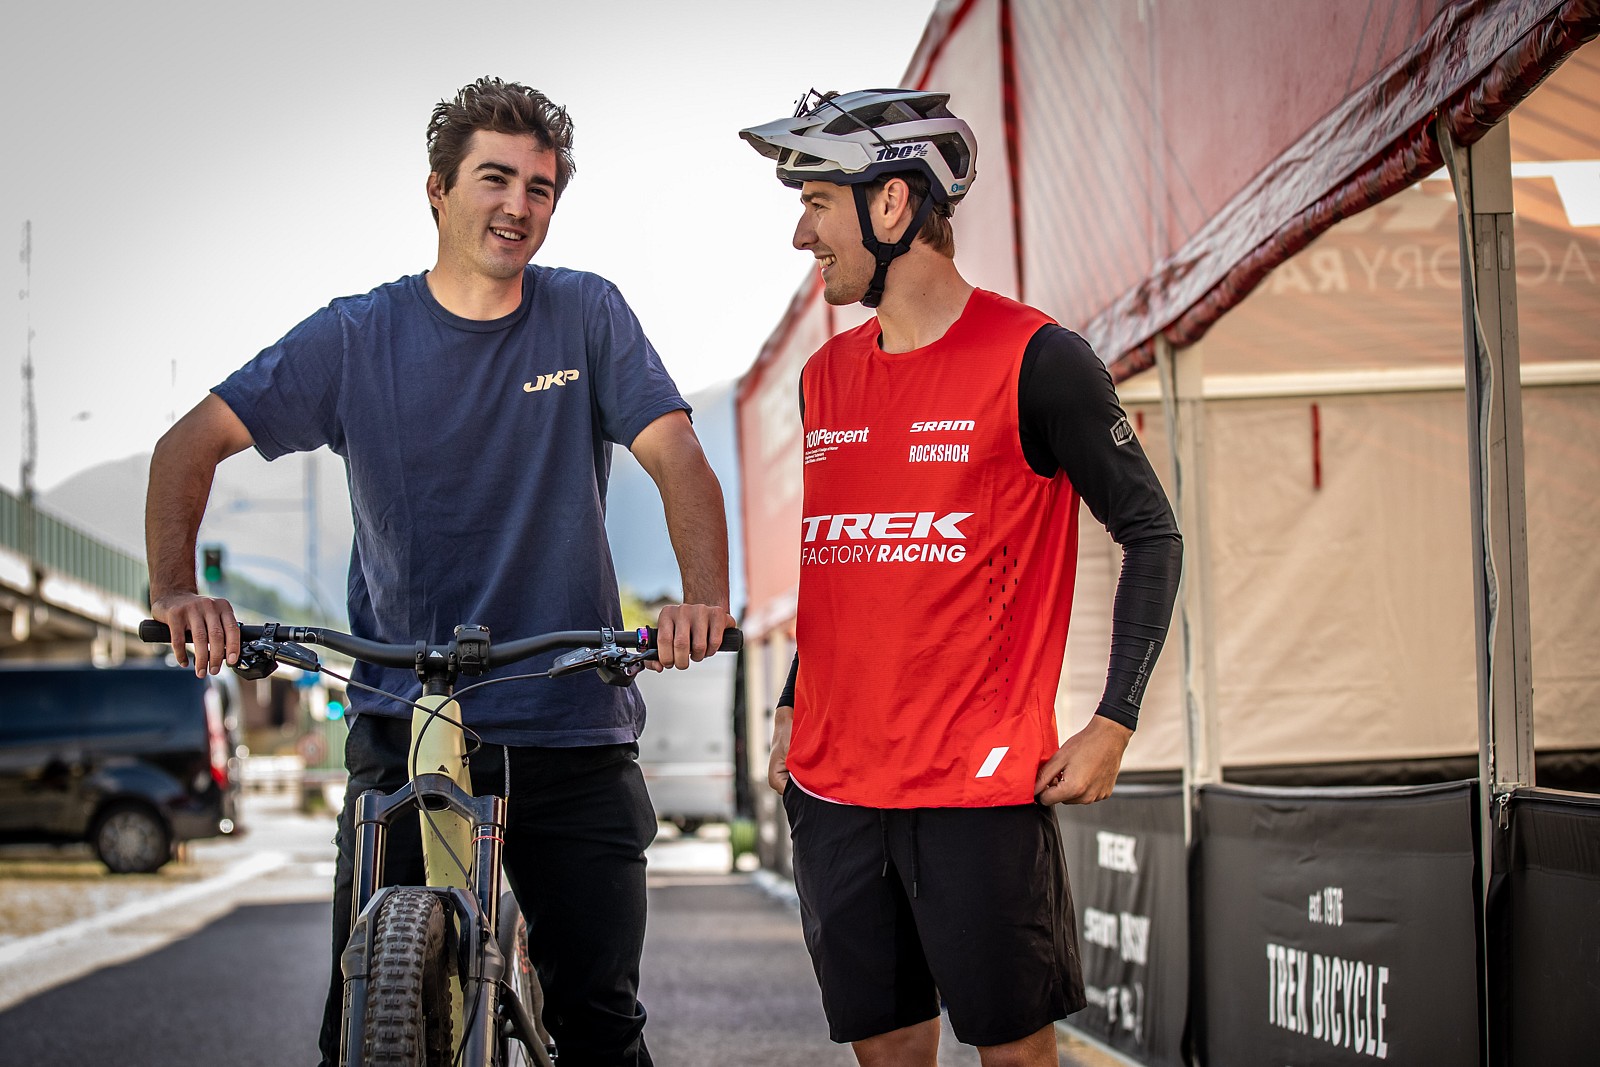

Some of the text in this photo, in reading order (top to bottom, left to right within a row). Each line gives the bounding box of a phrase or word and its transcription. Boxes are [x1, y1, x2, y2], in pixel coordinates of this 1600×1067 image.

[876, 143, 928, 161] 100%
[523, 369, 580, 392] JKP
[910, 420, 975, 432] SRAM
[805, 427, 869, 448] 100Percent
[908, 444, 970, 463] ROCKSHOX
[803, 512, 975, 542] TREK
[801, 543, 967, 565] FACTORY RACING
[1324, 886, 1344, 927] 1976
[1266, 943, 1390, 1060] TREK BICYCLE
